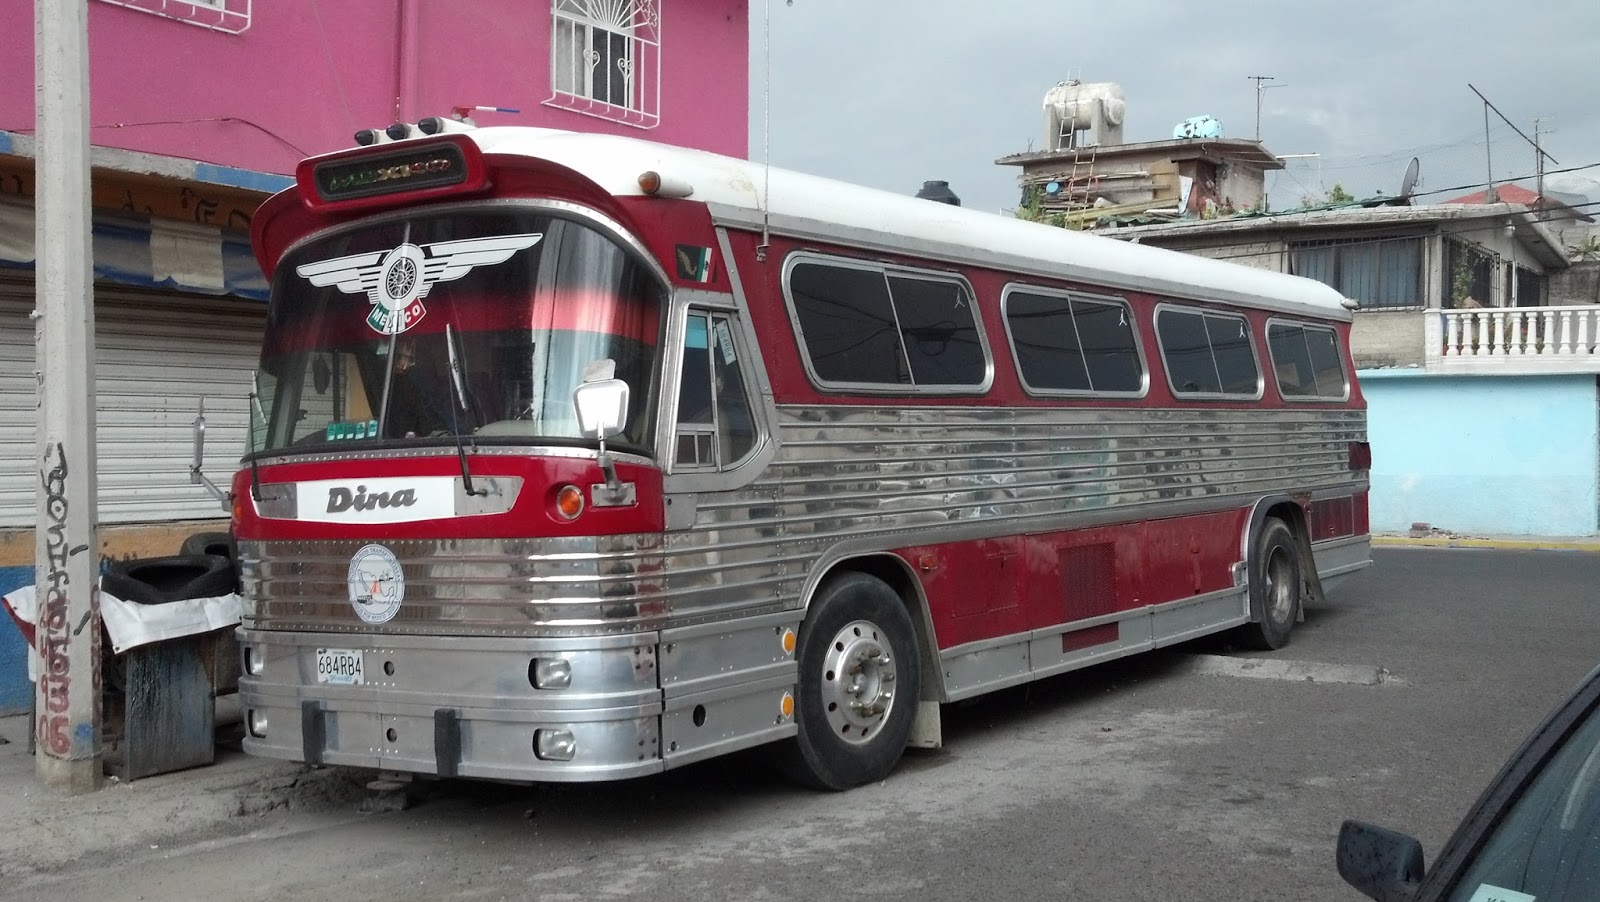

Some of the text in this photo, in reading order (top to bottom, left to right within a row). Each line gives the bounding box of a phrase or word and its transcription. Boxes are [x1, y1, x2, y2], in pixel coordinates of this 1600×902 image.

[371, 304, 421, 329] MEXICO
[326, 484, 418, 513] Dina
[318, 655, 362, 677] 684RB4
